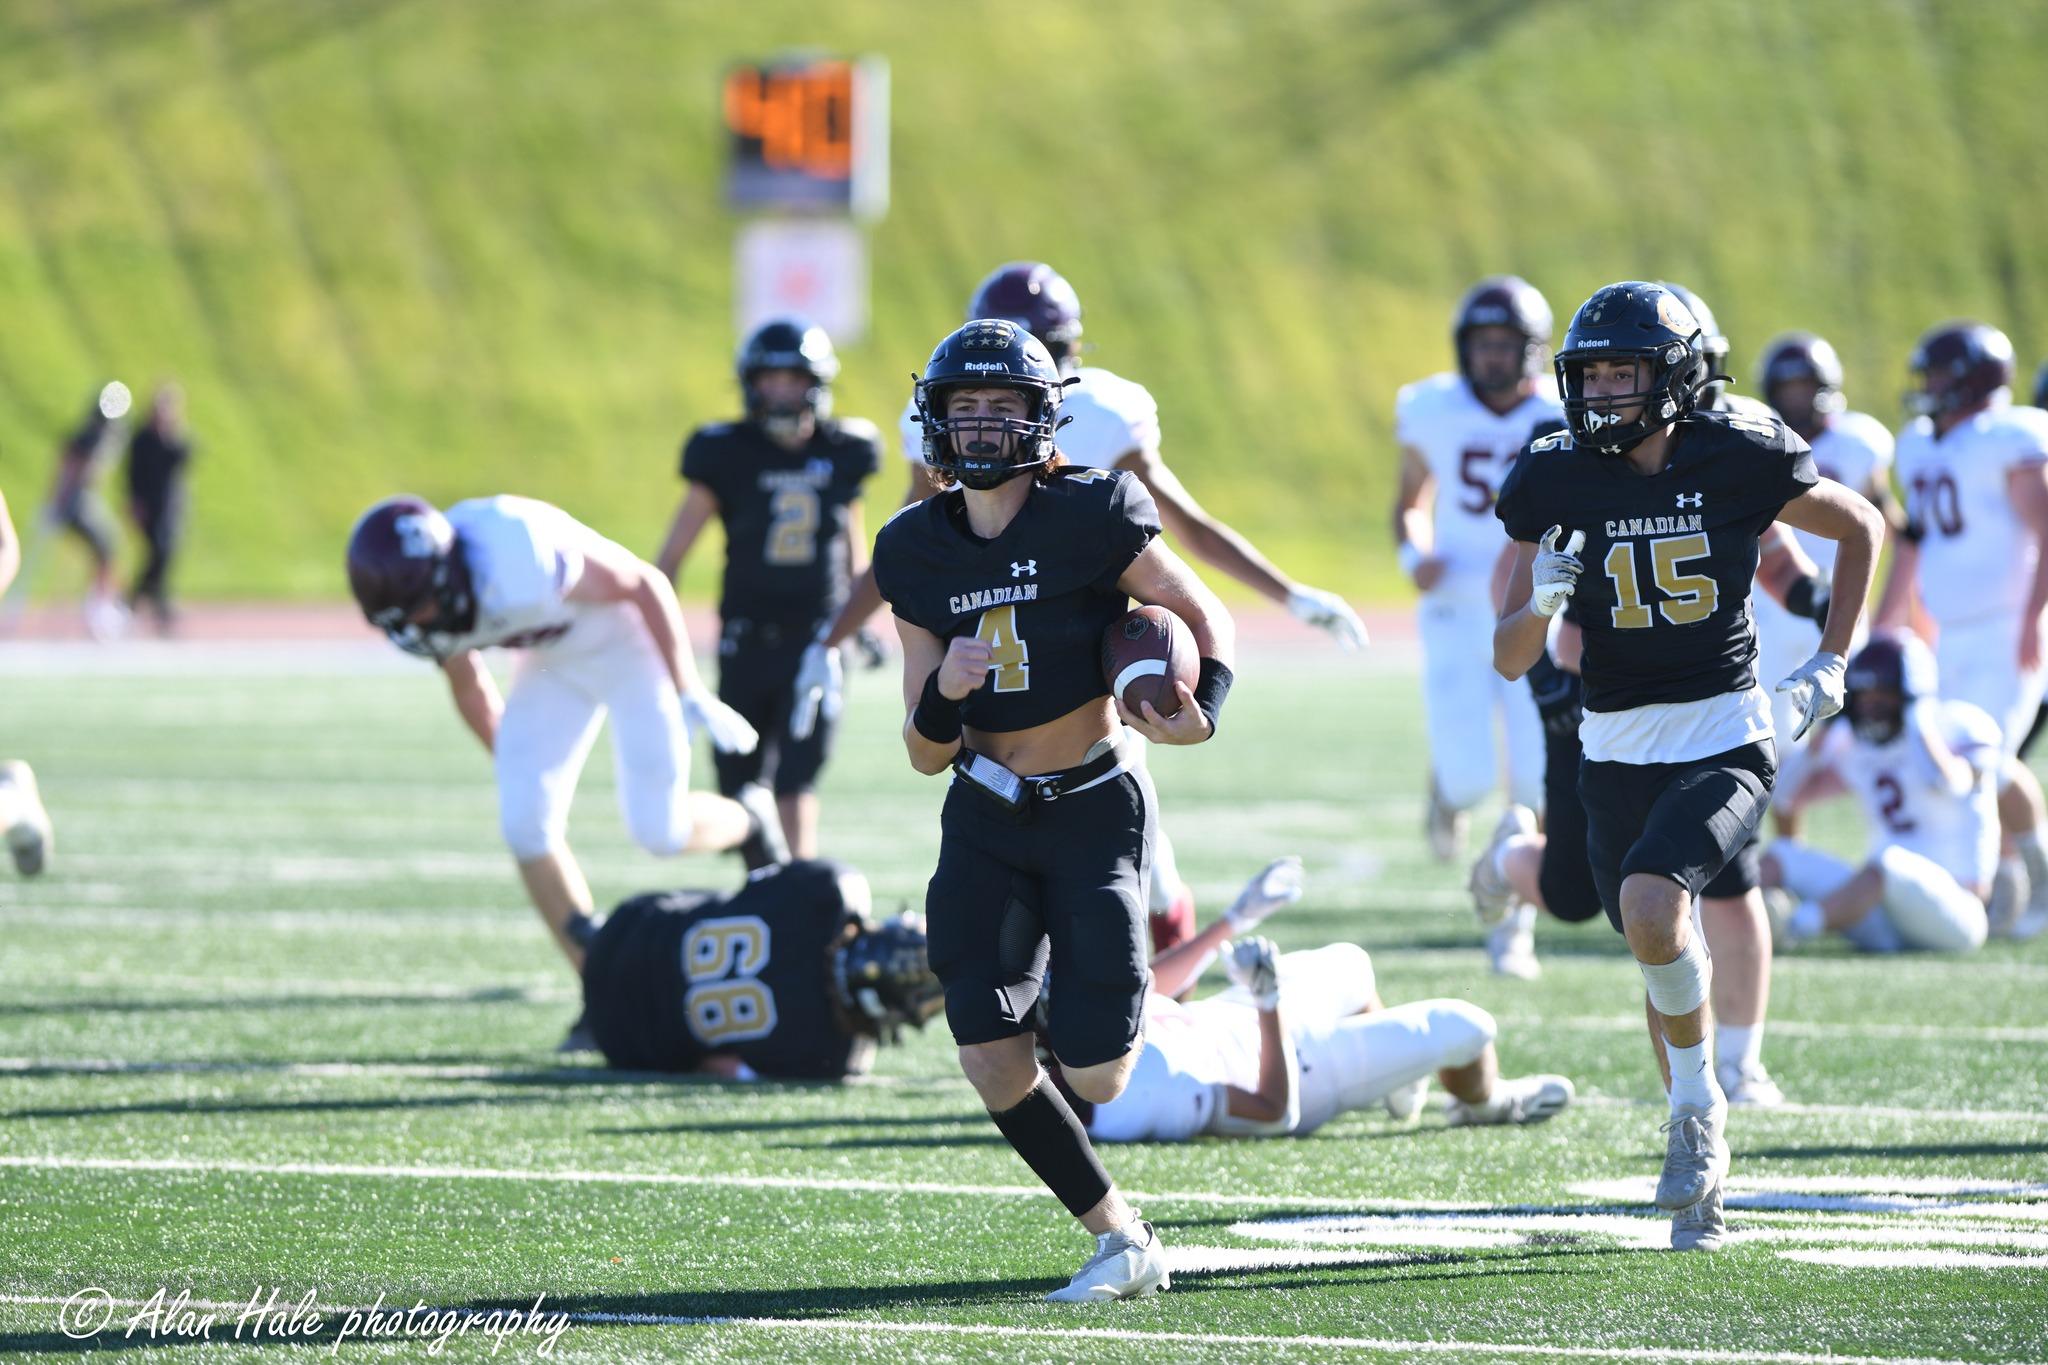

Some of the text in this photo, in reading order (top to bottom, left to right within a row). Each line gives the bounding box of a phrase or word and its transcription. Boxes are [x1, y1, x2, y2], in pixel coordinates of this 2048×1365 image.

[1577, 338, 1610, 348] Riddell
[964, 361, 1003, 371] Riddell
[764, 483, 819, 565] 2
[1605, 514, 1703, 538] CANADIAN
[949, 583, 1038, 614] CANADIAN
[1604, 531, 1720, 629] 15
[974, 604, 1030, 693] 4
[1875, 774, 1918, 833] 2
